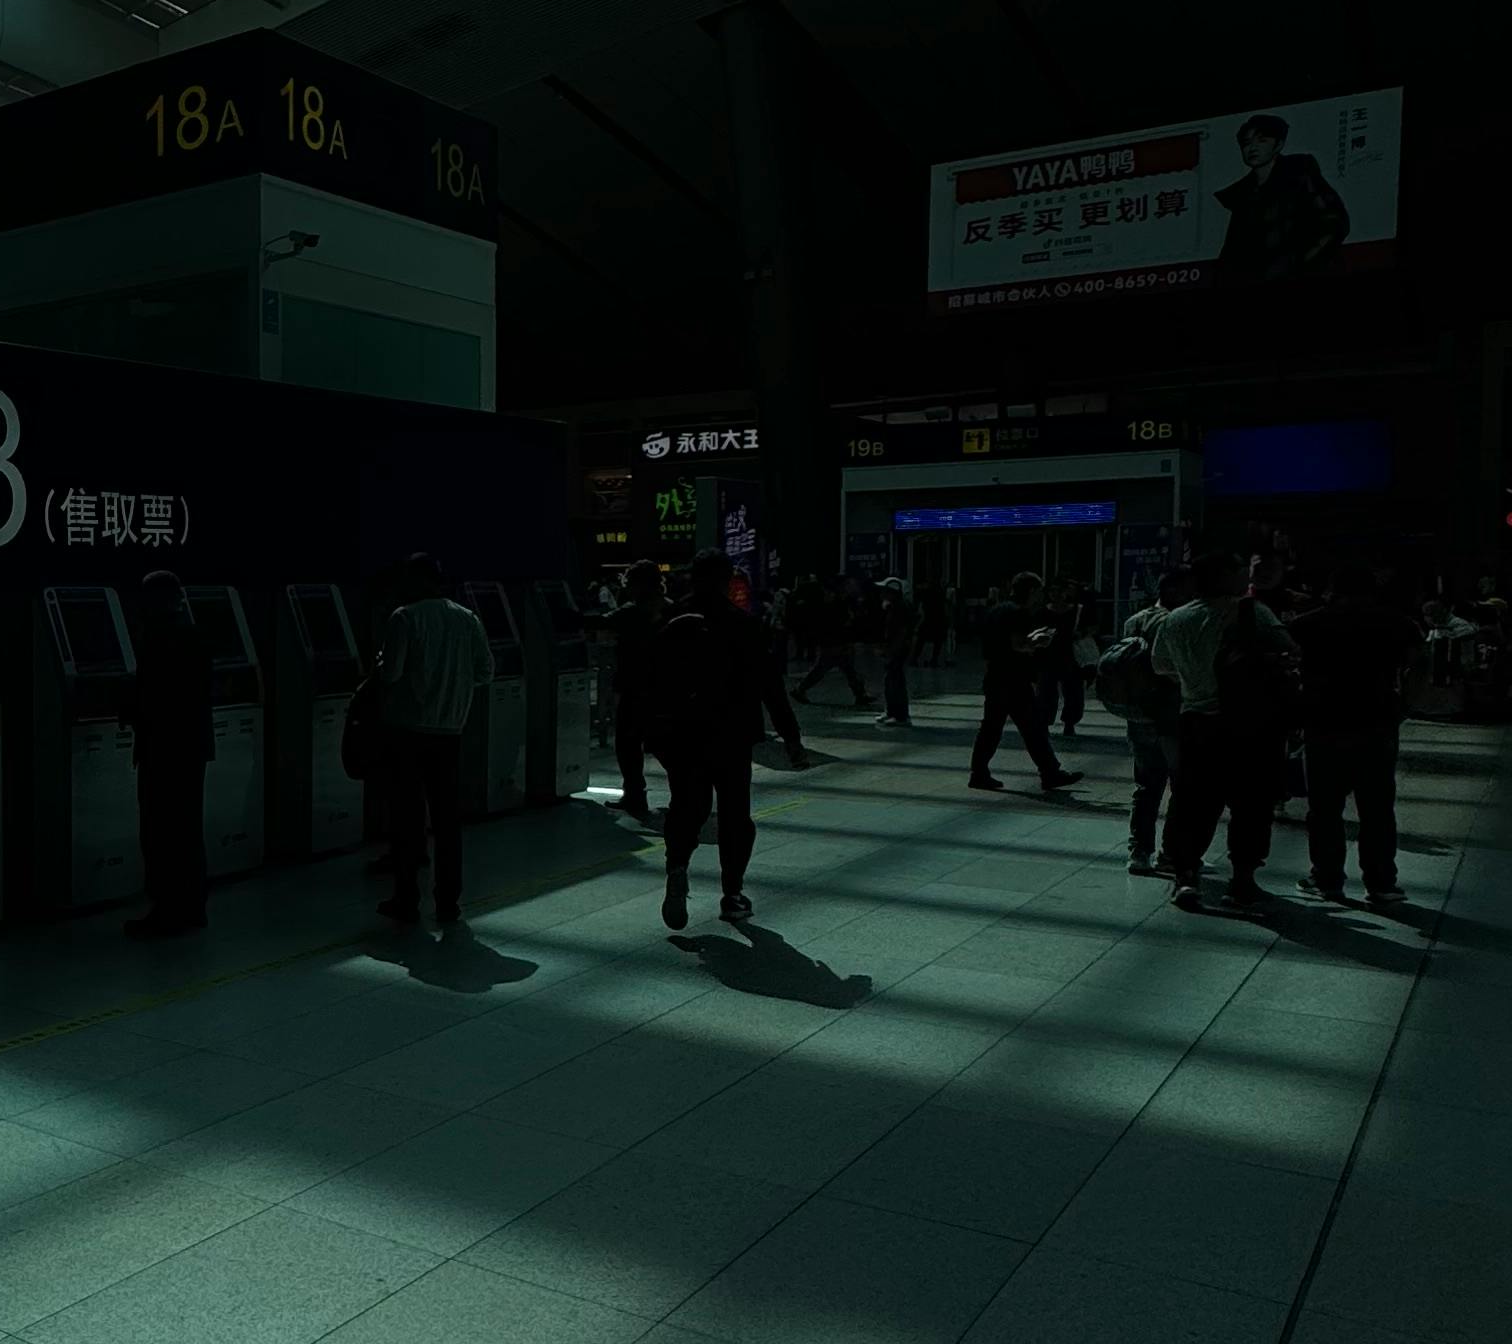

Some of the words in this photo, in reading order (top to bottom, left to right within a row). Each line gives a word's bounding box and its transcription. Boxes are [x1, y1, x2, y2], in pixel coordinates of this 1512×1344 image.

[145, 84, 246, 157] 18A
[280, 77, 348, 160] 18A
[431, 137, 486, 208] 18A
[962, 207, 1065, 245] 反季买
[1079, 189, 1189, 230] 更划算
[1073, 268, 1200, 294] 400-8659-020
[847, 439, 885, 457] 19B
[1127, 419, 1173, 441] 18B
[45, 488, 189, 547] (售取票)
